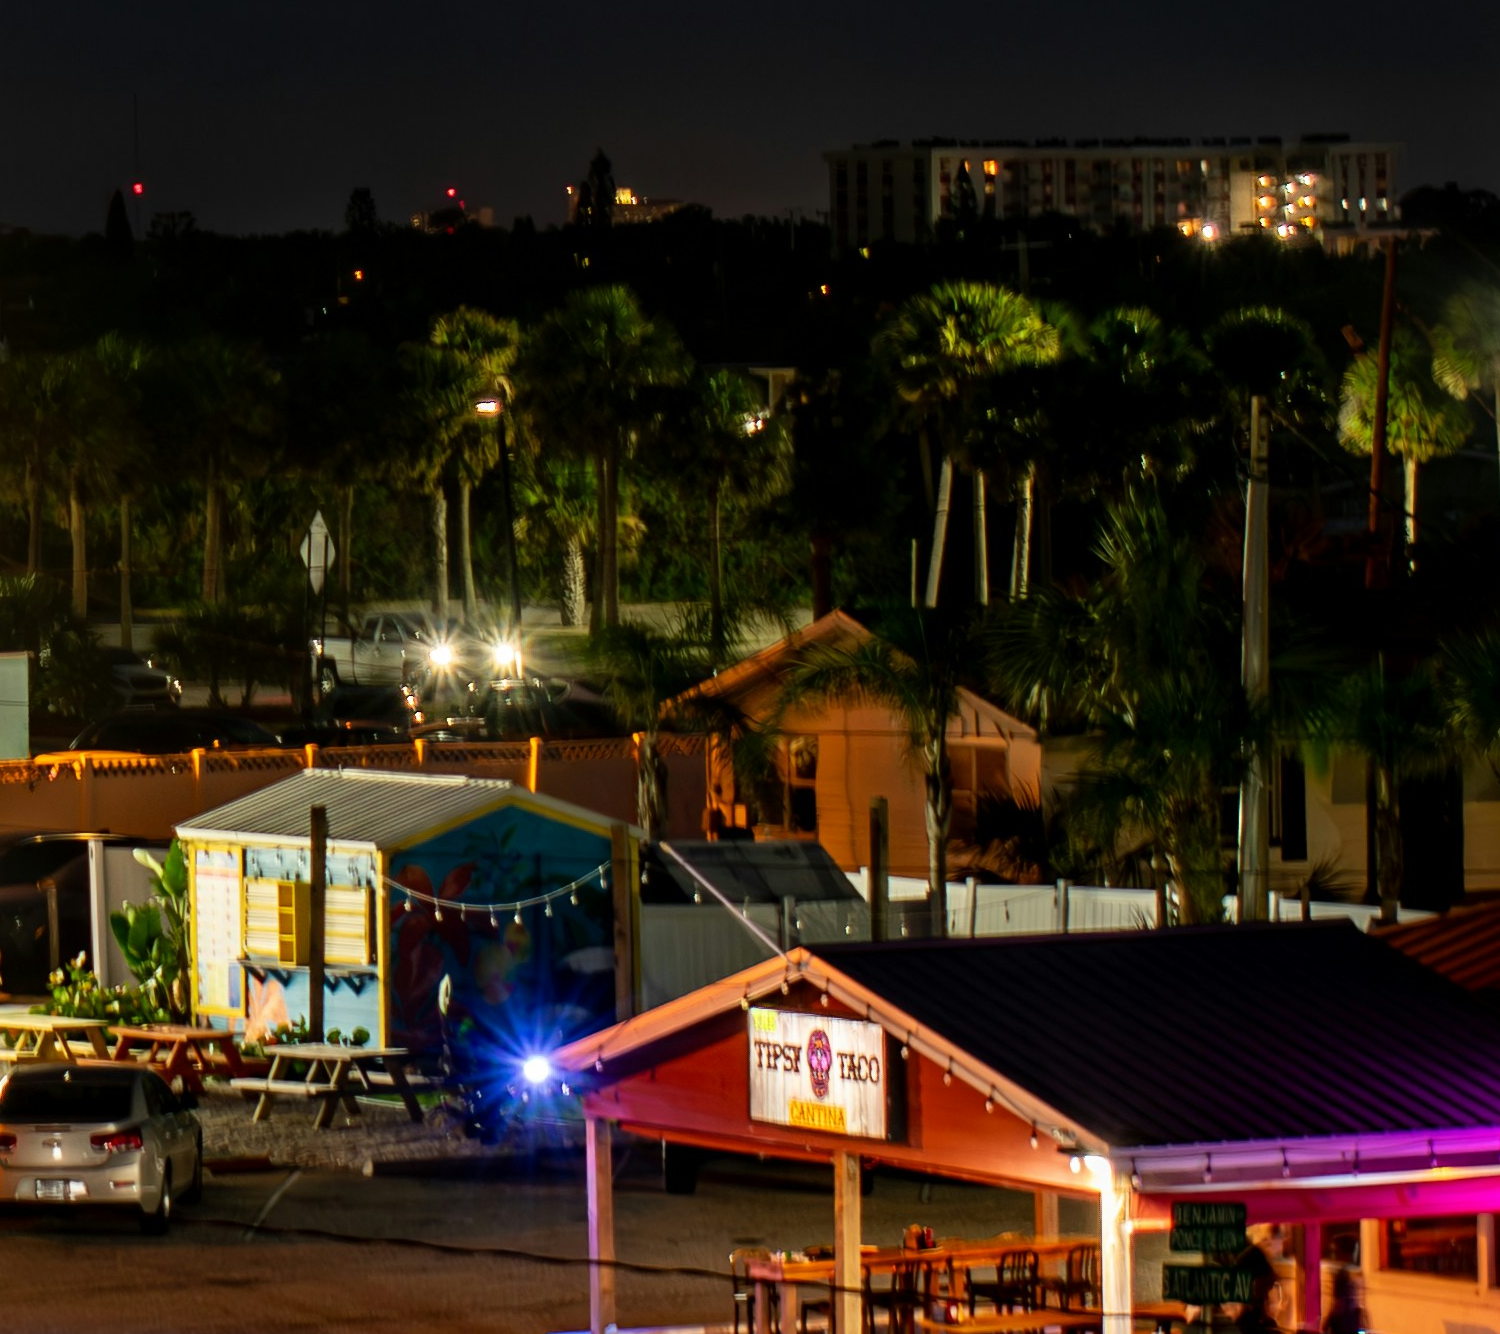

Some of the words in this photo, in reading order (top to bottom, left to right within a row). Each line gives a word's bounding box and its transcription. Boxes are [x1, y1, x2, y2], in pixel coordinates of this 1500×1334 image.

[754, 1040, 802, 1073] TIPSY
[837, 1052, 880, 1083] TACO
[790, 1100, 845, 1127] CANTINA
[1174, 1204, 1236, 1226] BENJAMIN
[1173, 1270, 1231, 1300] ATLANTIC
